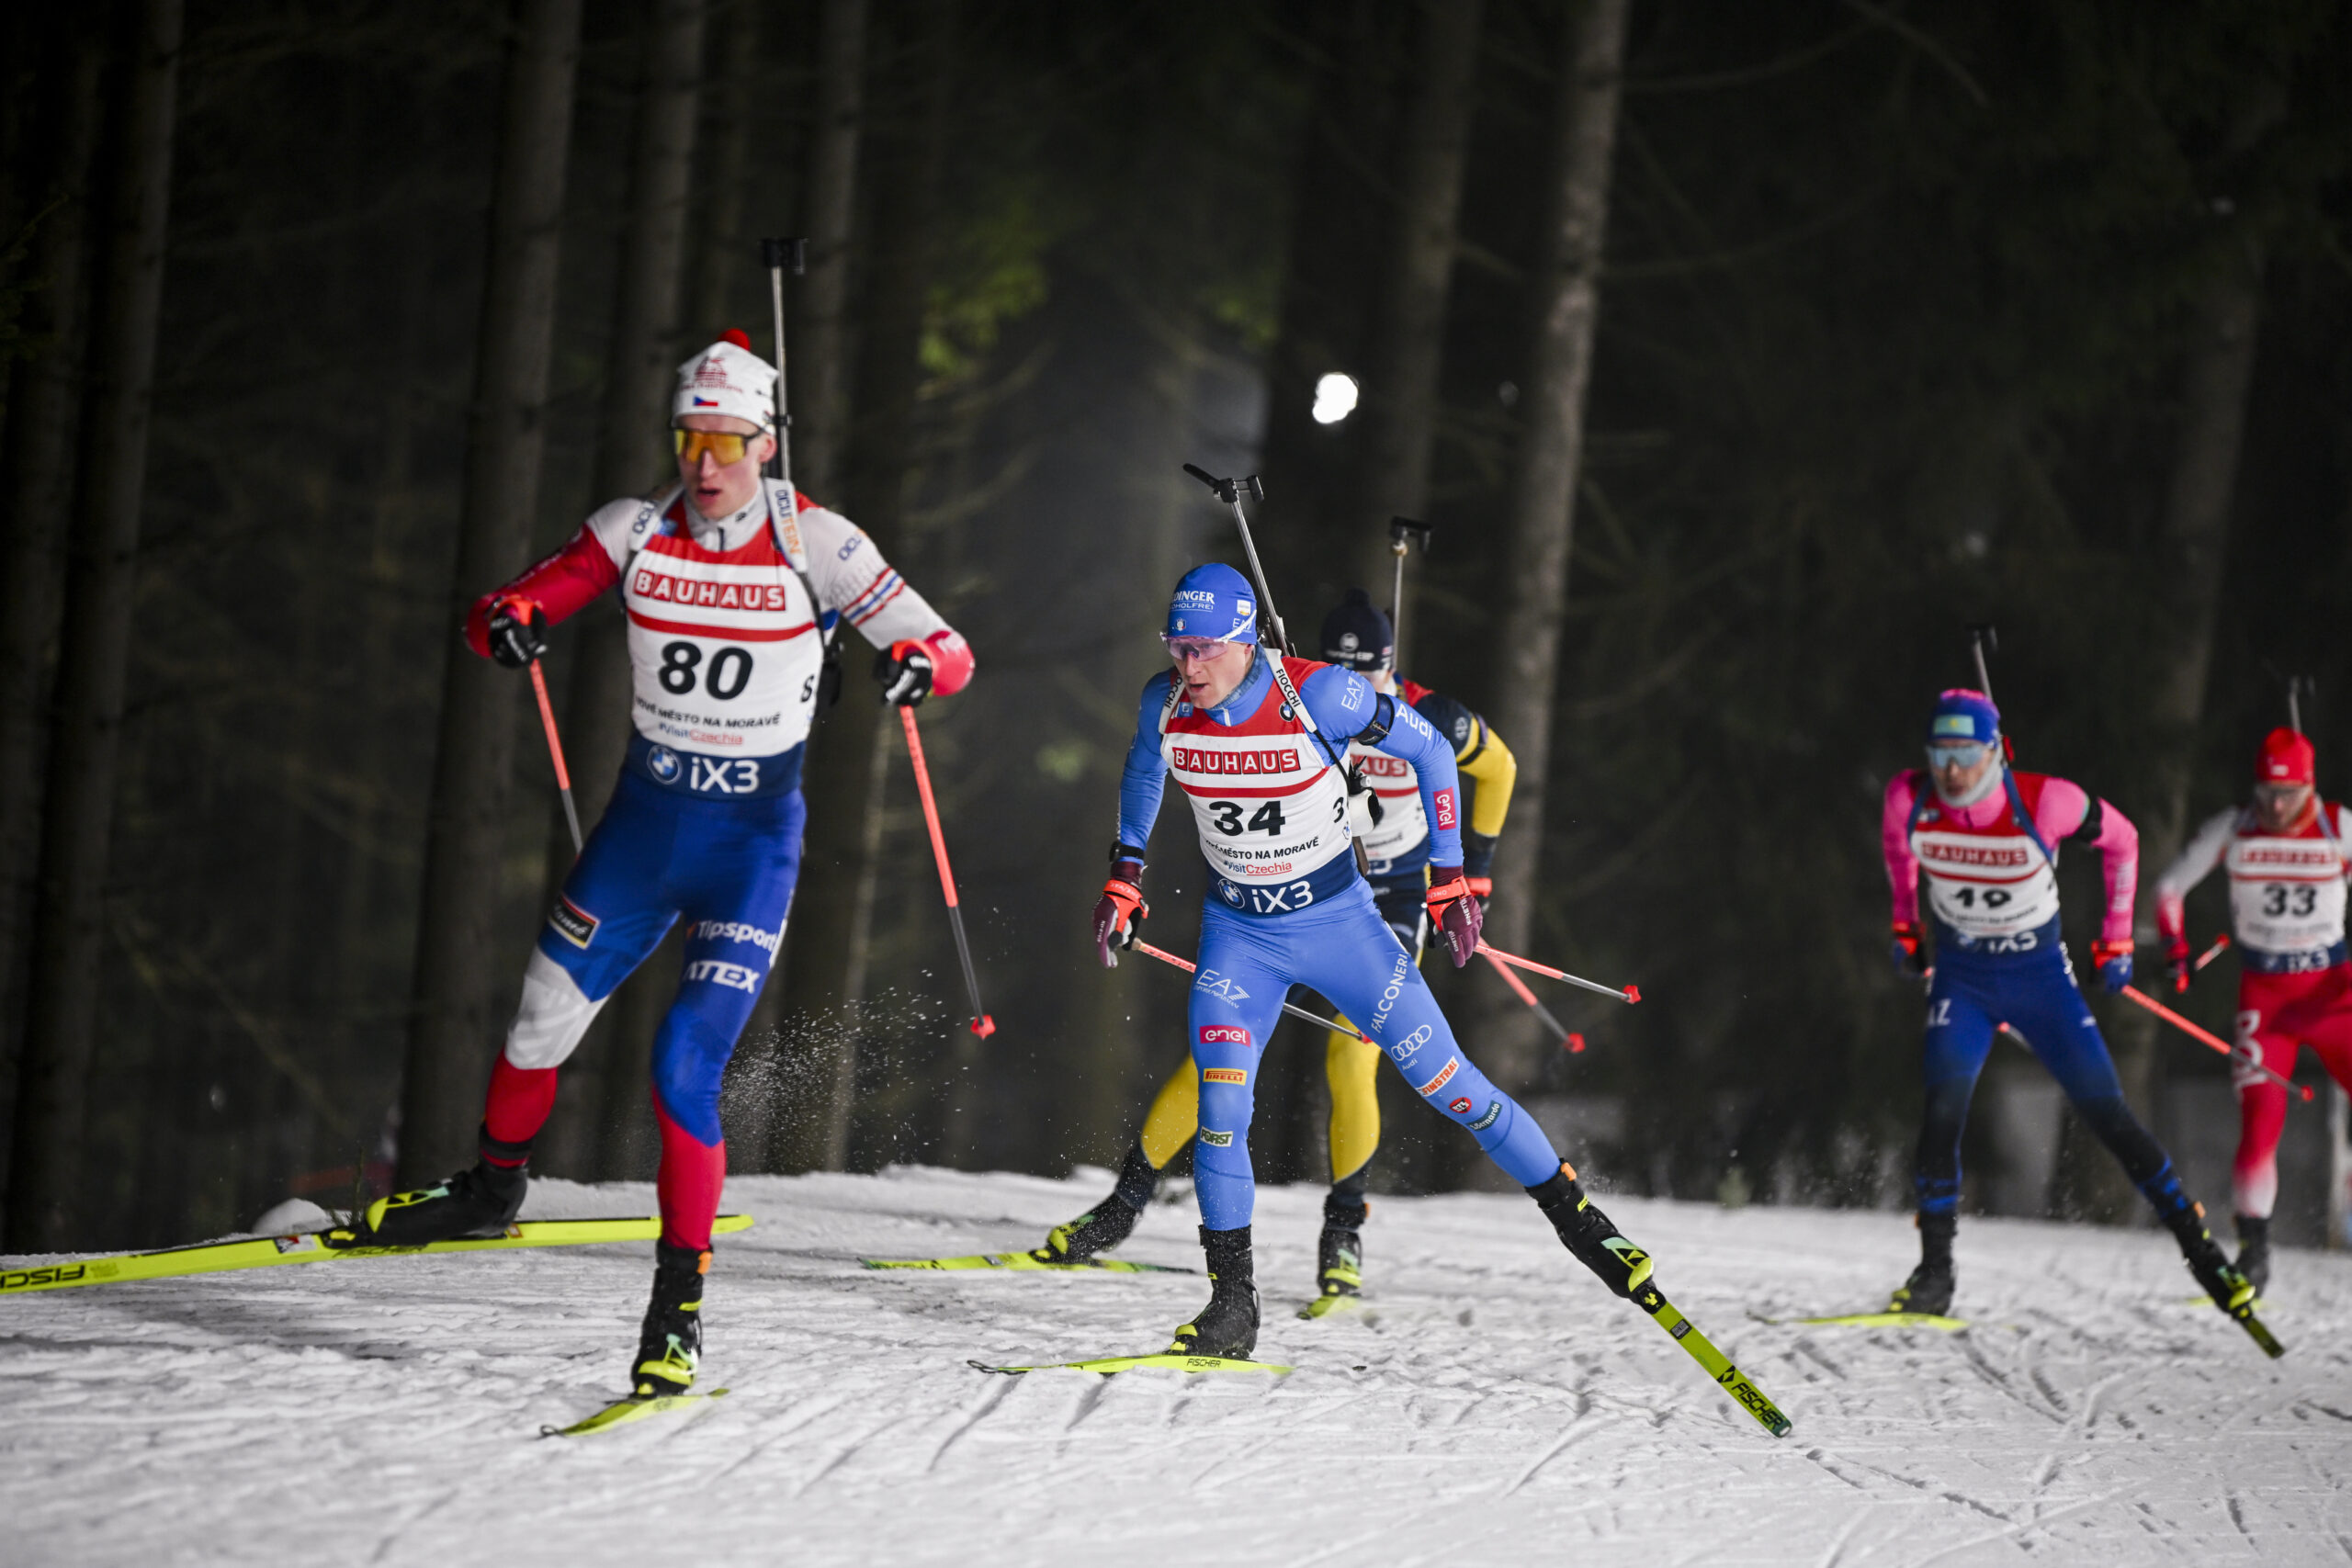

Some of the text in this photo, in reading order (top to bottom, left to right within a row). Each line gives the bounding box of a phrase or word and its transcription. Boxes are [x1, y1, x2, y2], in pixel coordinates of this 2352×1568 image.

[634, 569, 786, 611] BAUHAUS
[658, 640, 753, 700] 80
[1276, 669, 1300, 707] FIOCCHI
[1341, 676, 1361, 710] EA7
[703, 716, 720, 728] NA
[1396, 704, 1433, 740] Audi
[690, 756, 760, 794] iX3
[1173, 747, 1301, 774] BAUHAUS
[1209, 800, 1285, 836] 34
[1437, 794, 1455, 826] enel
[1255, 851, 1271, 859] NA
[1274, 836, 1319, 858] MORAVĚ
[1251, 880, 1314, 913] iX3
[2264, 884, 2316, 917] 33
[684, 960, 761, 994] ATEX
[1197, 969, 1250, 1000] EA7
[1371, 953, 1408, 1033] FALCONERI
[1205, 1029, 1246, 1043] enel
[1205, 1070, 1244, 1082] PIRELLI
[1402, 1058, 1419, 1071] Audi
[1422, 1060, 1457, 1095] FINSTRAL
[1201, 1129, 1232, 1145] FORST
[1187, 1358, 1221, 1368] FISCHER
[1731, 1382, 1783, 1429] FISCHER
